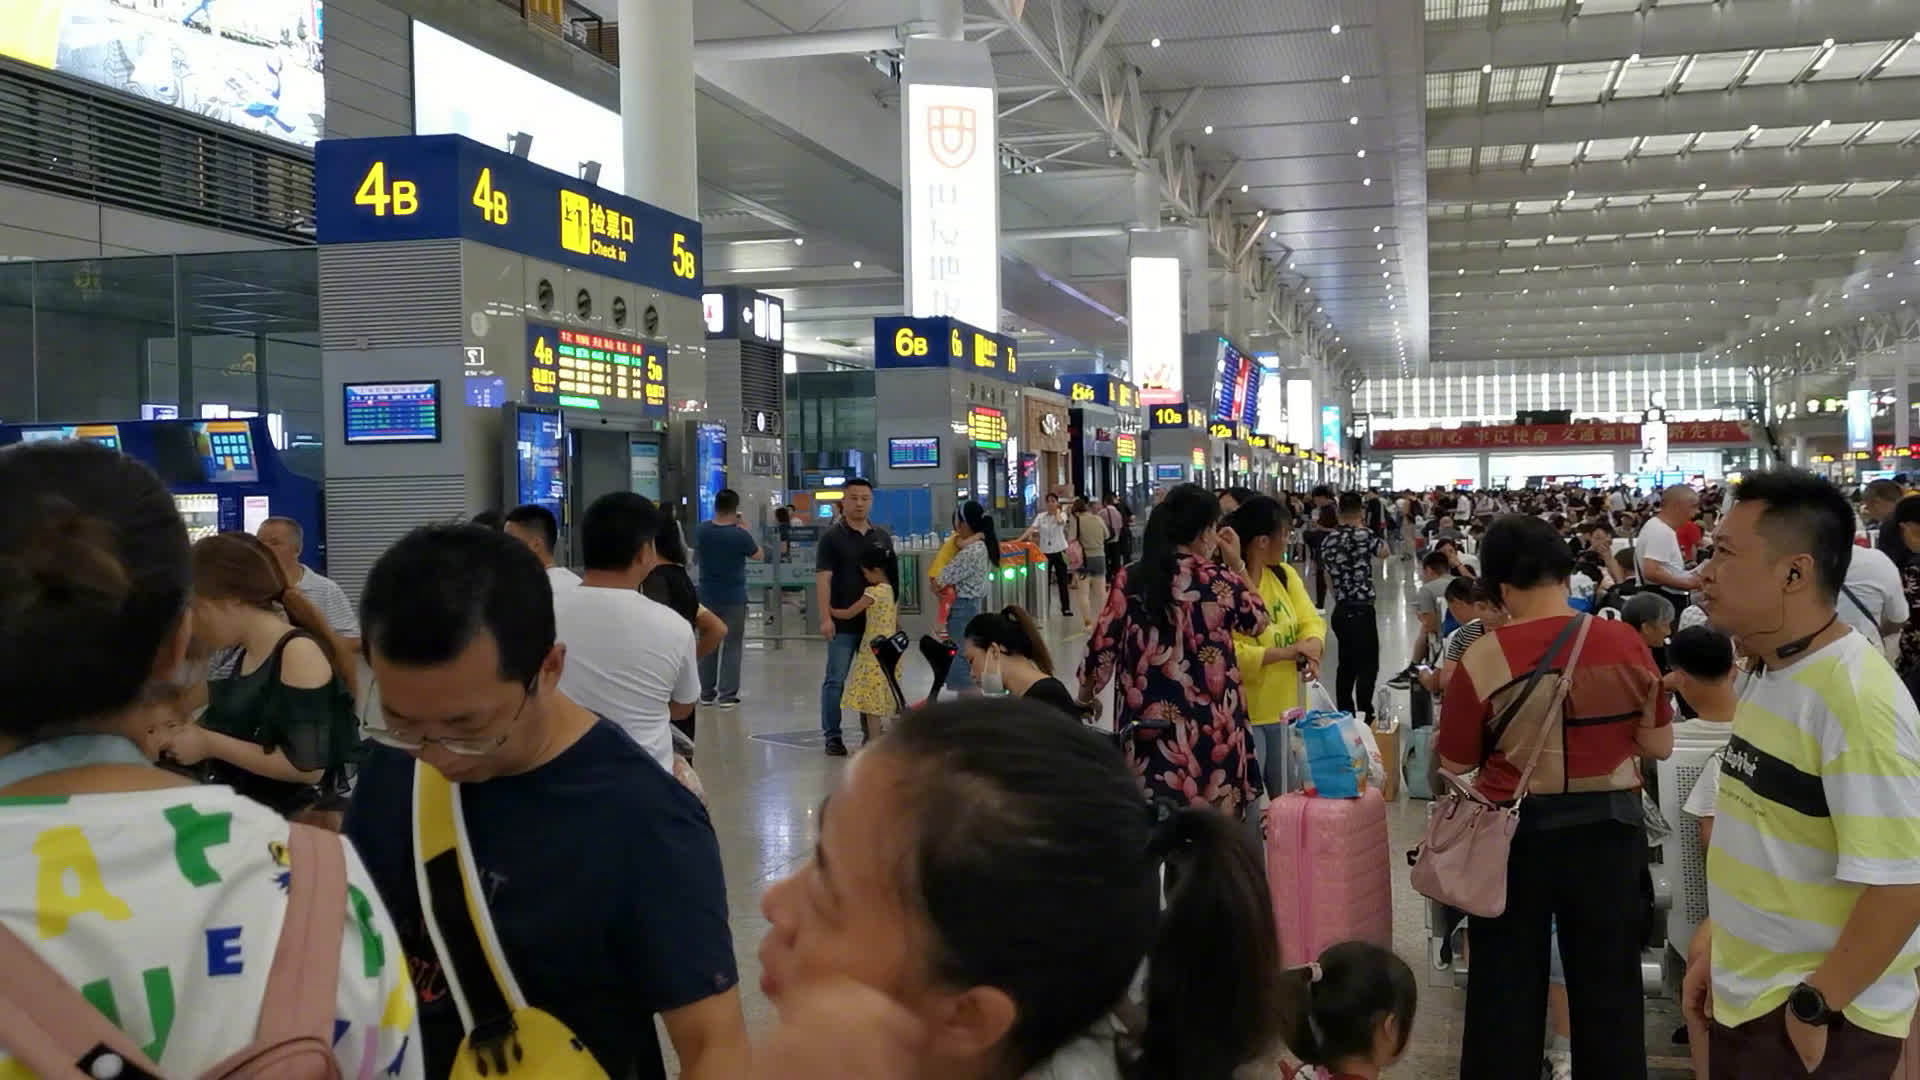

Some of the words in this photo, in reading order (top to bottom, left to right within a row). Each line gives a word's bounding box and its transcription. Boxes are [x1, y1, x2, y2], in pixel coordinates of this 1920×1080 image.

[354, 161, 419, 217] 4B
[472, 167, 509, 226] 4B
[591, 203, 634, 244] 检票口
[591, 240, 617, 260] Check
[618, 247, 627, 262] in
[672, 233, 695, 279] 5B
[533, 336, 554, 365] 4B
[895, 327, 929, 357] 6B
[1155, 408, 1183, 424] 10B
[1209, 424, 1233, 438] 12B
[1562, 426, 1636, 441] 交通强国
[204, 925, 245, 977] E
